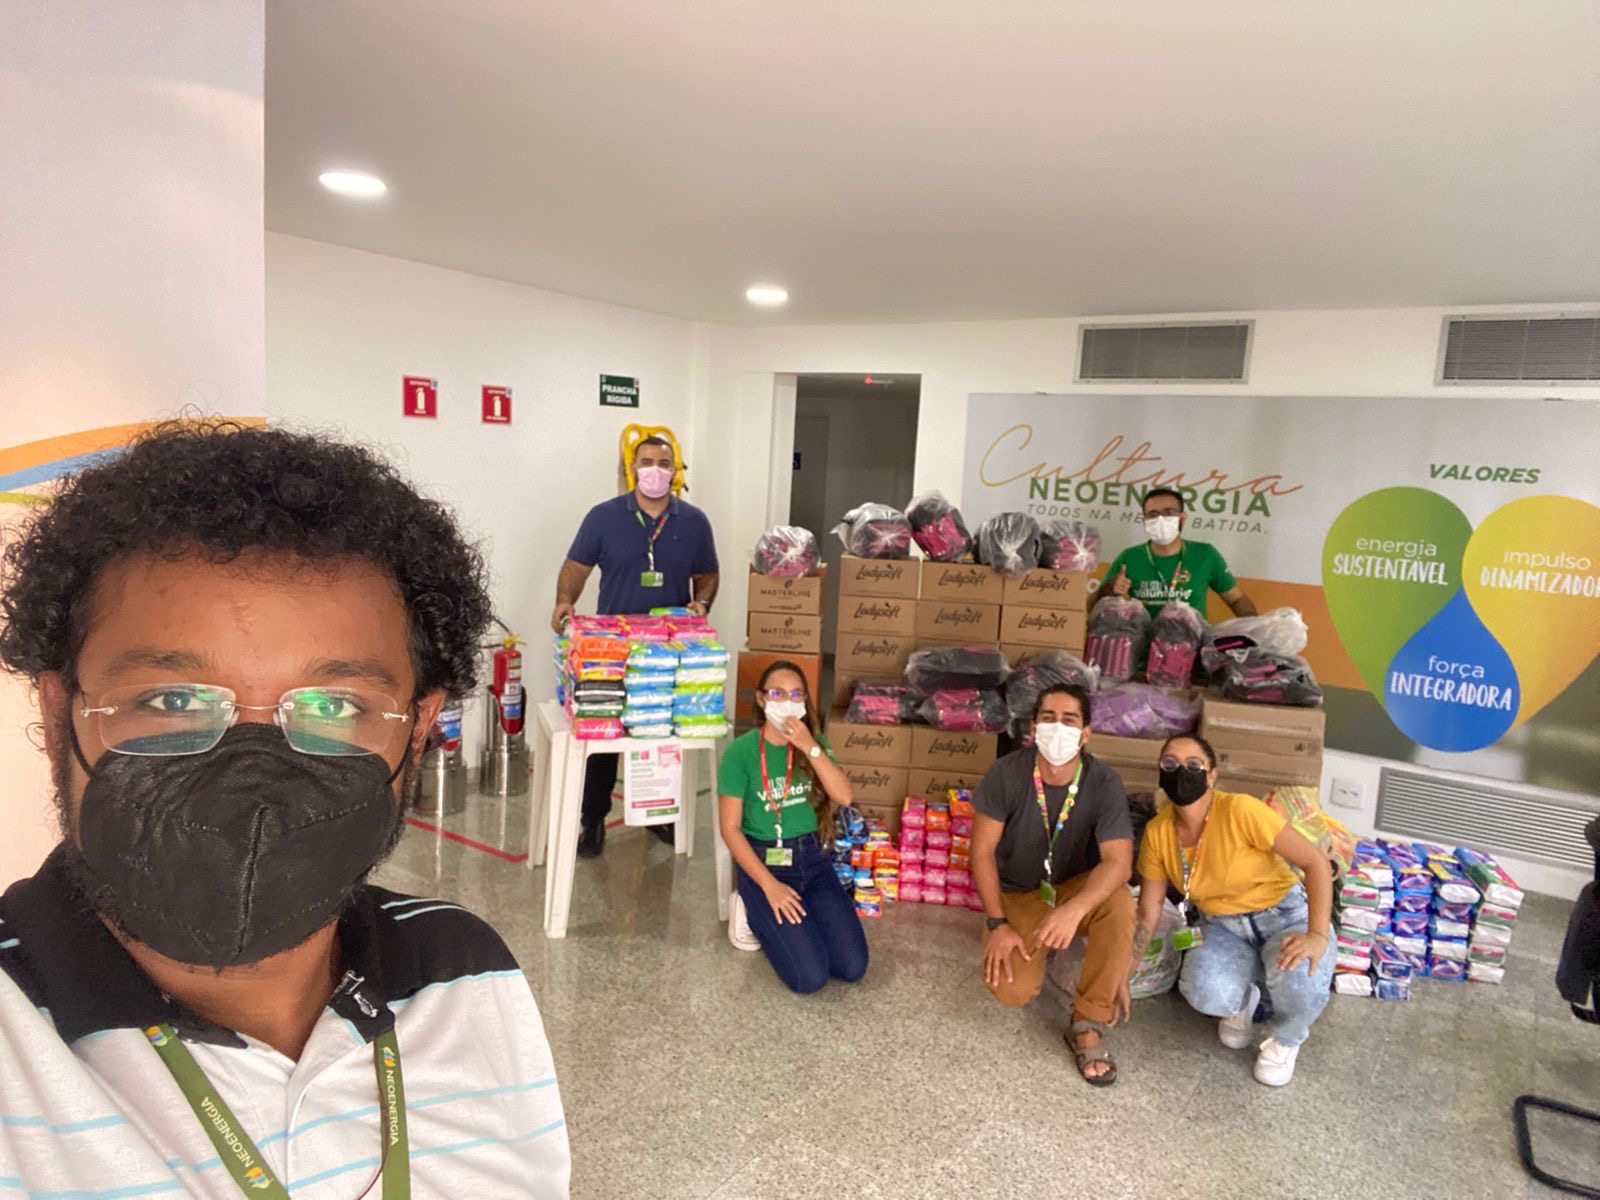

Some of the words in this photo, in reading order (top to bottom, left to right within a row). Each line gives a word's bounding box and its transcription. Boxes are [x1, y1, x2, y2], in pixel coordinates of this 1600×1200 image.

[601, 385, 637, 396] PRANCHA
[979, 423, 1304, 497] Cultura
[1429, 463, 1541, 485] VALORES
[1028, 476, 1271, 517] NEOENRGIA
[1028, 504, 1081, 518] TODOS
[1089, 509, 1112, 521] NA
[1356, 537, 1437, 561] energia
[1503, 549, 1592, 571] impulso
[1333, 553, 1449, 586] SUSTENTÁVEL
[1428, 656, 1485, 679] força
[1390, 671, 1512, 711] INTEGRADORA
[386, 1070, 399, 1146] NEOENERGIA
[201, 1096, 254, 1168] NEOENERGIA
